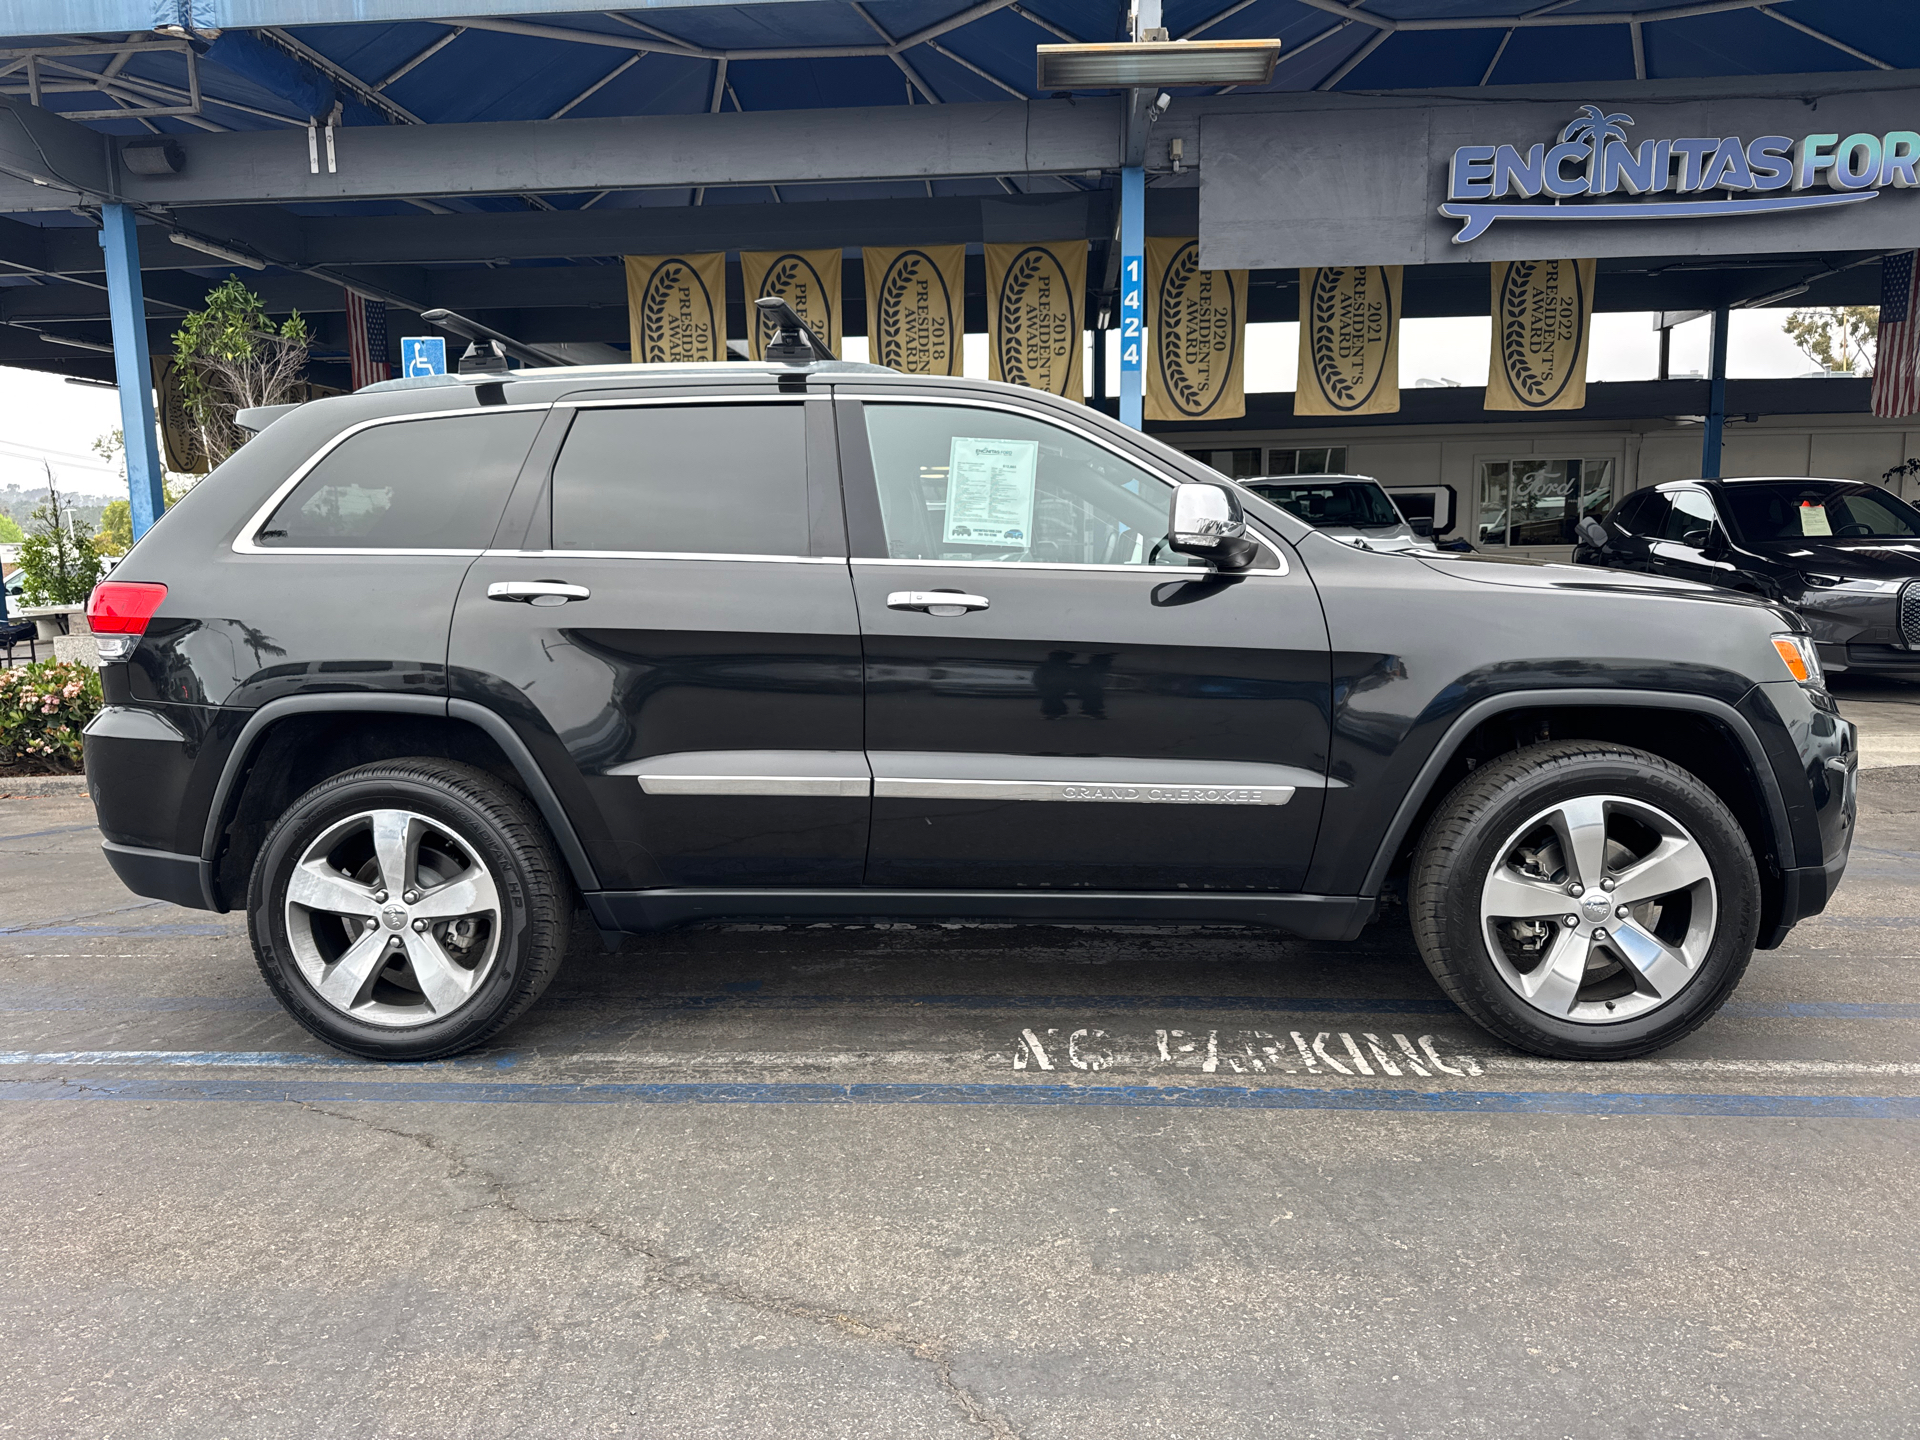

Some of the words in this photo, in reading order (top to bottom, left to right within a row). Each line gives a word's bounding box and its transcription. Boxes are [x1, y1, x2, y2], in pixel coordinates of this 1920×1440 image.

[1450, 108, 1795, 199] ENCINITAS
[1794, 130, 1920, 192] FOR
[904, 306, 919, 373] AWARD
[916, 279, 931, 375] PRESIDEN
[931, 316, 946, 361] 2018
[1026, 303, 1039, 370] AWARD
[1053, 313, 1067, 357] 2019
[1123, 260, 1140, 365] 1424
[1185, 297, 1199, 365] AWARD
[1198, 270, 1212, 392] PRESIDENT'S
[1213, 307, 1228, 352] 2020
[1338, 292, 1353, 359] AWARD
[1351, 266, 1367, 386] PRESIDENT'S
[1367, 302, 1382, 344] 2021
[1529, 286, 1545, 354] AWARD
[1540, 260, 1559, 381] PRESIDENT'S
[1557, 296, 1574, 341] 2022
[1516, 469, 1576, 496] Ford
[1061, 787, 1140, 800] GRAND
[1147, 789, 1263, 802] CHEROKEE
[1647, 774, 1730, 843] GENERAL
[440, 800, 512, 872] ROADIAN
[508, 882, 524, 908] HP
[1586, 902, 1607, 915] Jeep
